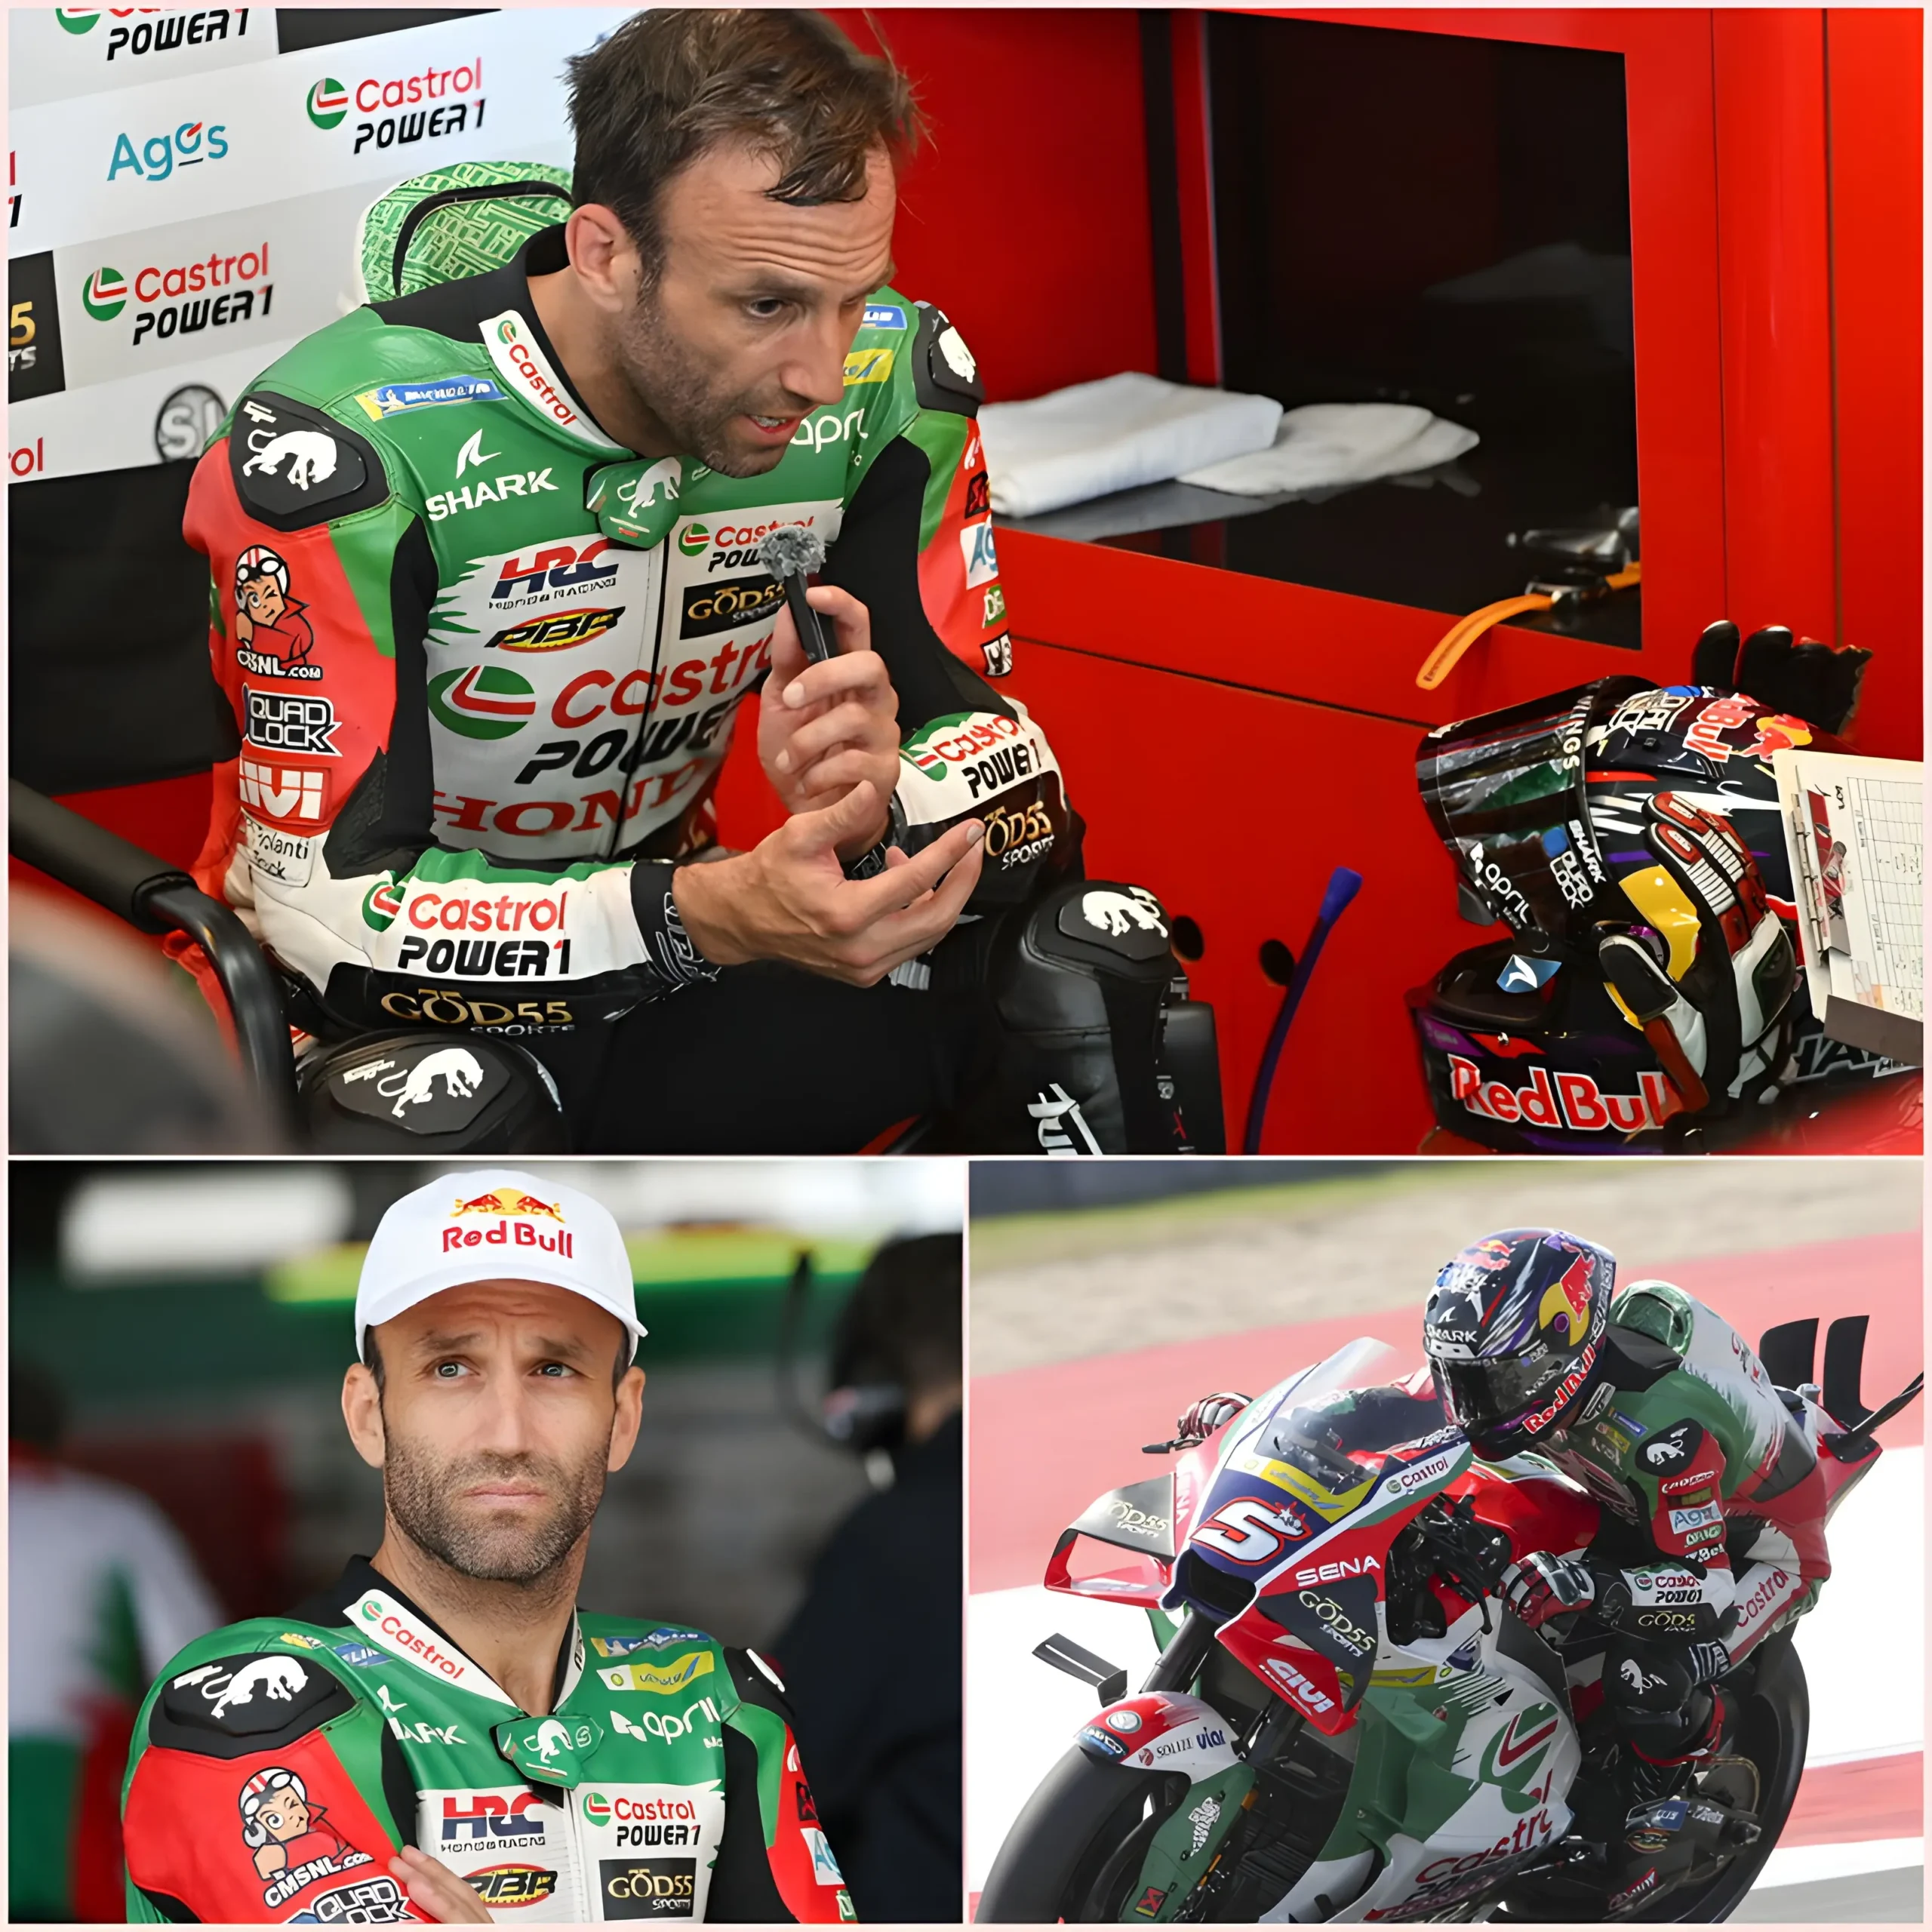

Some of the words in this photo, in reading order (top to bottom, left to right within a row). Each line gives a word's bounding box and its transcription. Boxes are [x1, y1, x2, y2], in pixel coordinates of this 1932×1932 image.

[107, 9, 250, 60] POWER1
[355, 57, 483, 113] Castrol
[107, 122, 229, 181] Agos
[353, 98, 487, 155] POWER1
[135, 242, 269, 303] Castrol
[132, 284, 274, 346] POWER1
[509, 344, 577, 426] Castrol
[426, 467, 559, 521] SHARK
[491, 539, 620, 599] HRC
[709, 551, 761, 573] POW
[250, 697, 331, 725] QUAD
[251, 724, 329, 751] LOCK
[433, 758, 705, 837] HOND
[983, 801, 1054, 857] OD55
[408, 891, 569, 932] Castrol
[398, 935, 571, 977] POWER1
[1447, 1054, 1563, 1130] Red
[1554, 1072, 1665, 1134] Bul
[442, 1220, 507, 1254] Red
[514, 1222, 574, 1259] Bull
[1295, 1555, 1380, 1587] SENA
[380, 1616, 466, 1681] Castrol
[1266, 1657, 1335, 1713] GIVI
[441, 1791, 544, 1841] HRC
[614, 1798, 697, 1821] Castrol
[616, 1824, 701, 1847] POWER1
[315, 1879, 397, 1923] QUAD
[345, 1900, 411, 1924] OCK
